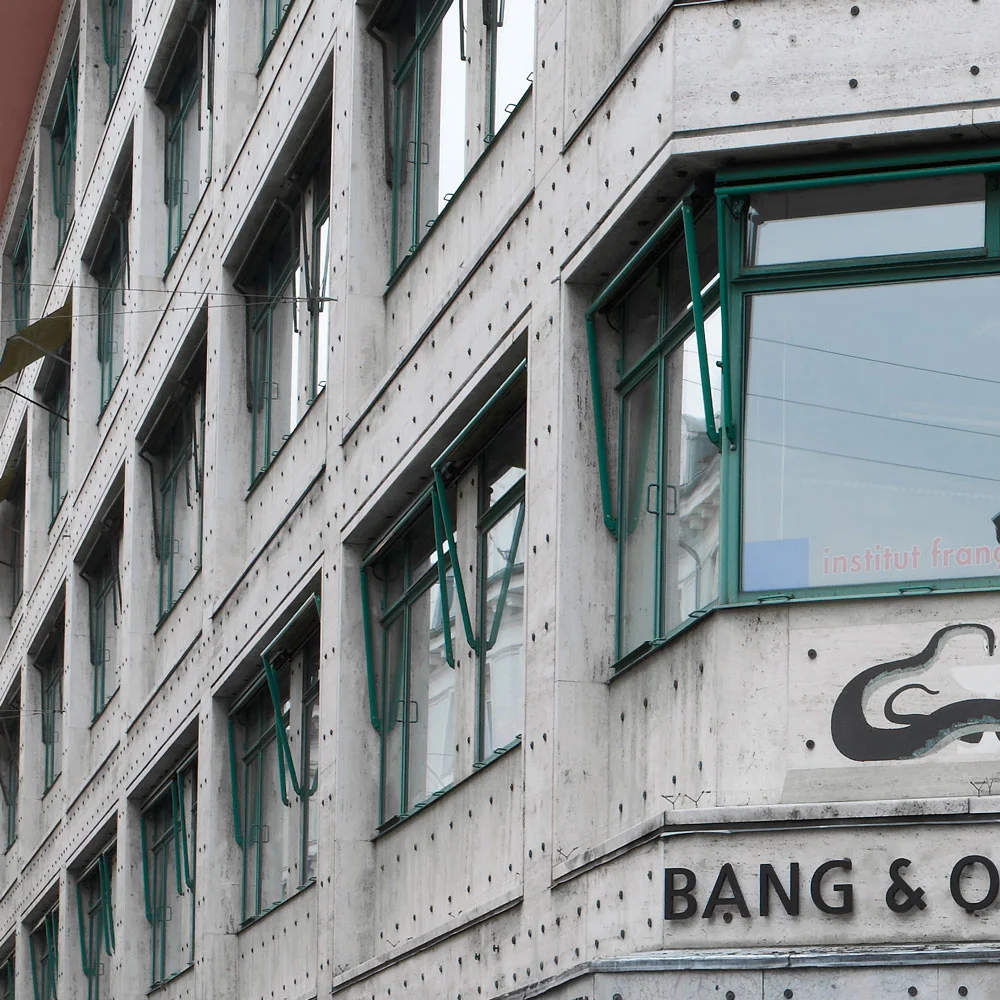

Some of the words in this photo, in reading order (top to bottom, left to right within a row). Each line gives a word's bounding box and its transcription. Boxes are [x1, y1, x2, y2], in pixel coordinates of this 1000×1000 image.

[823, 544, 920, 574] institut
[663, 857, 853, 921] BANG
[885, 858, 928, 914] &
